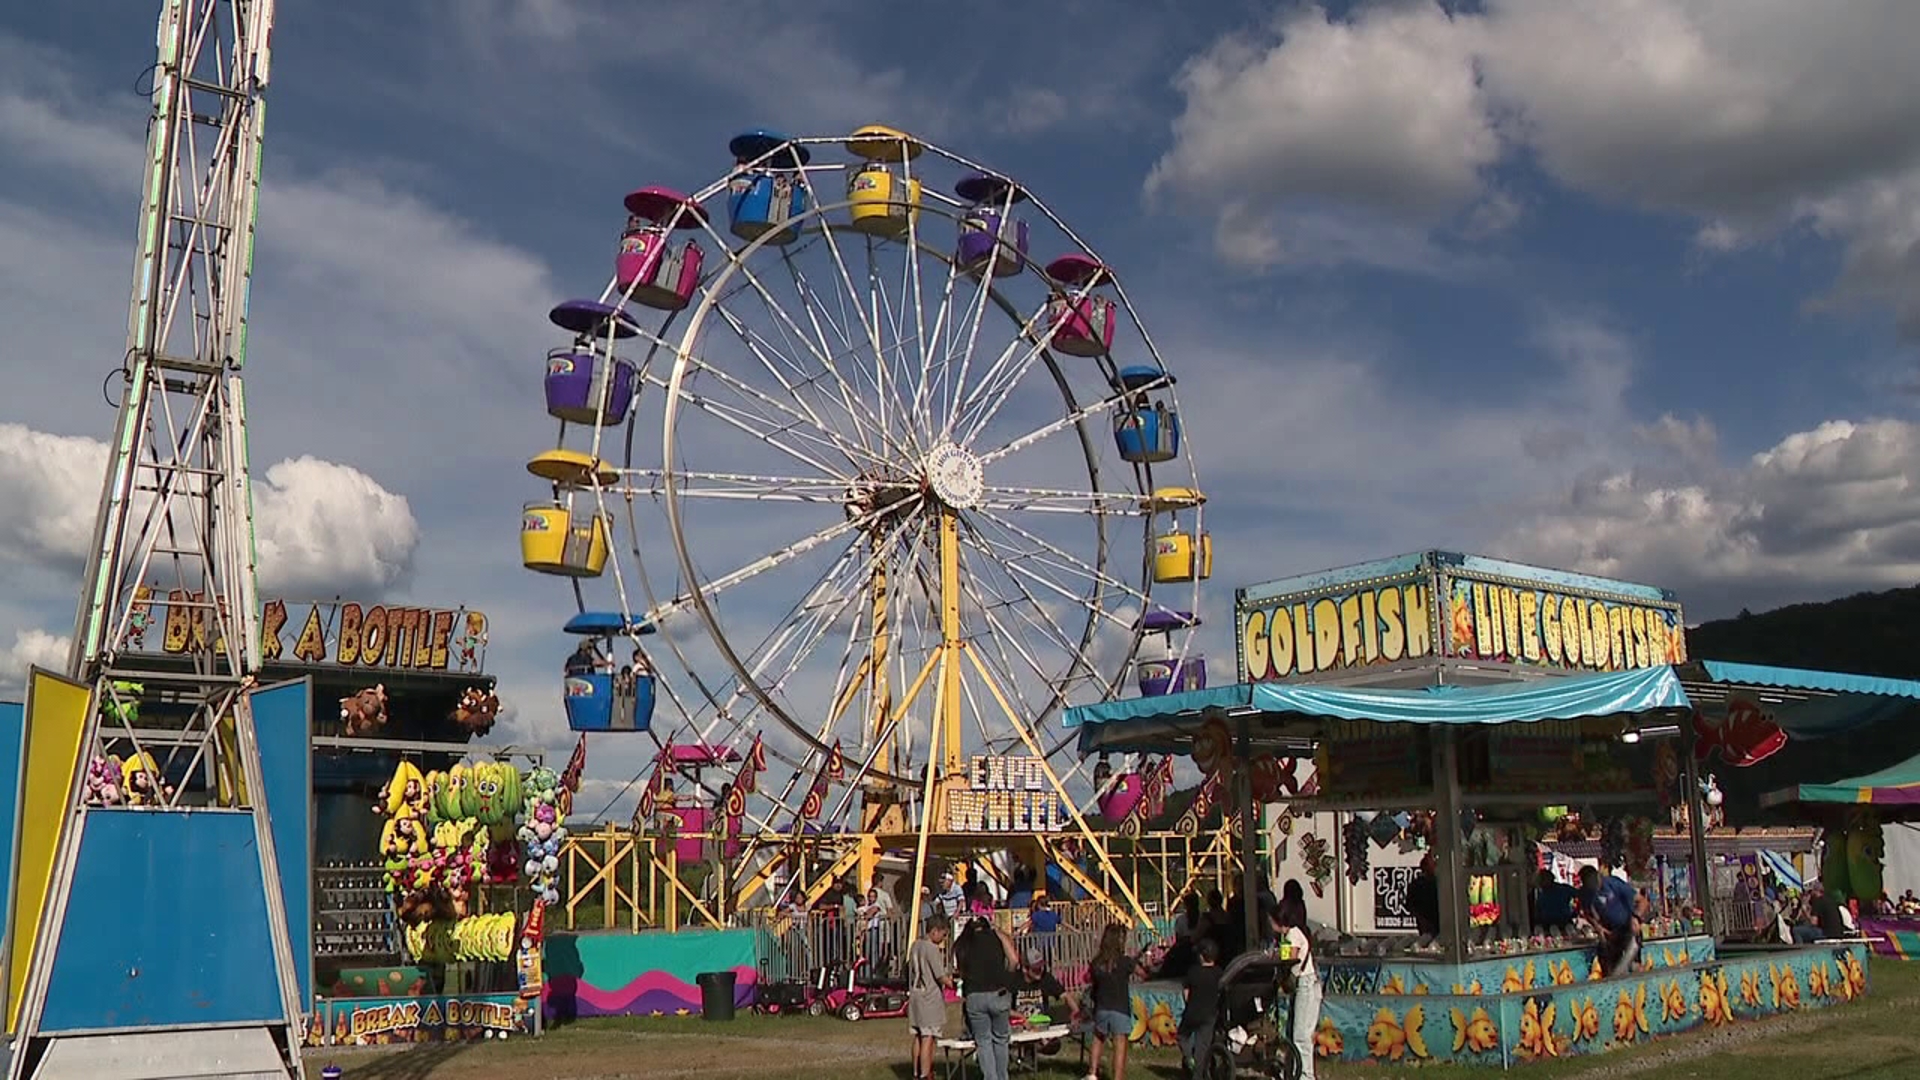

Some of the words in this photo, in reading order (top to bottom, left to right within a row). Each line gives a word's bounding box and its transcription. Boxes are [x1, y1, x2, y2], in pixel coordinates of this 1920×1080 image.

[163, 588, 288, 661] BRK
[294, 602, 326, 662] A
[336, 602, 454, 669] BOTTLE
[1246, 584, 1431, 681] GOLDFISH
[1472, 581, 1541, 661] LIVE
[1541, 592, 1669, 669] GOLDFISH
[971, 755, 1042, 789] EXPO
[949, 789, 1062, 832] WHEEL
[351, 1001, 420, 1036] BREAK
[423, 1001, 444, 1026] A
[446, 999, 514, 1030] BOTTLE
